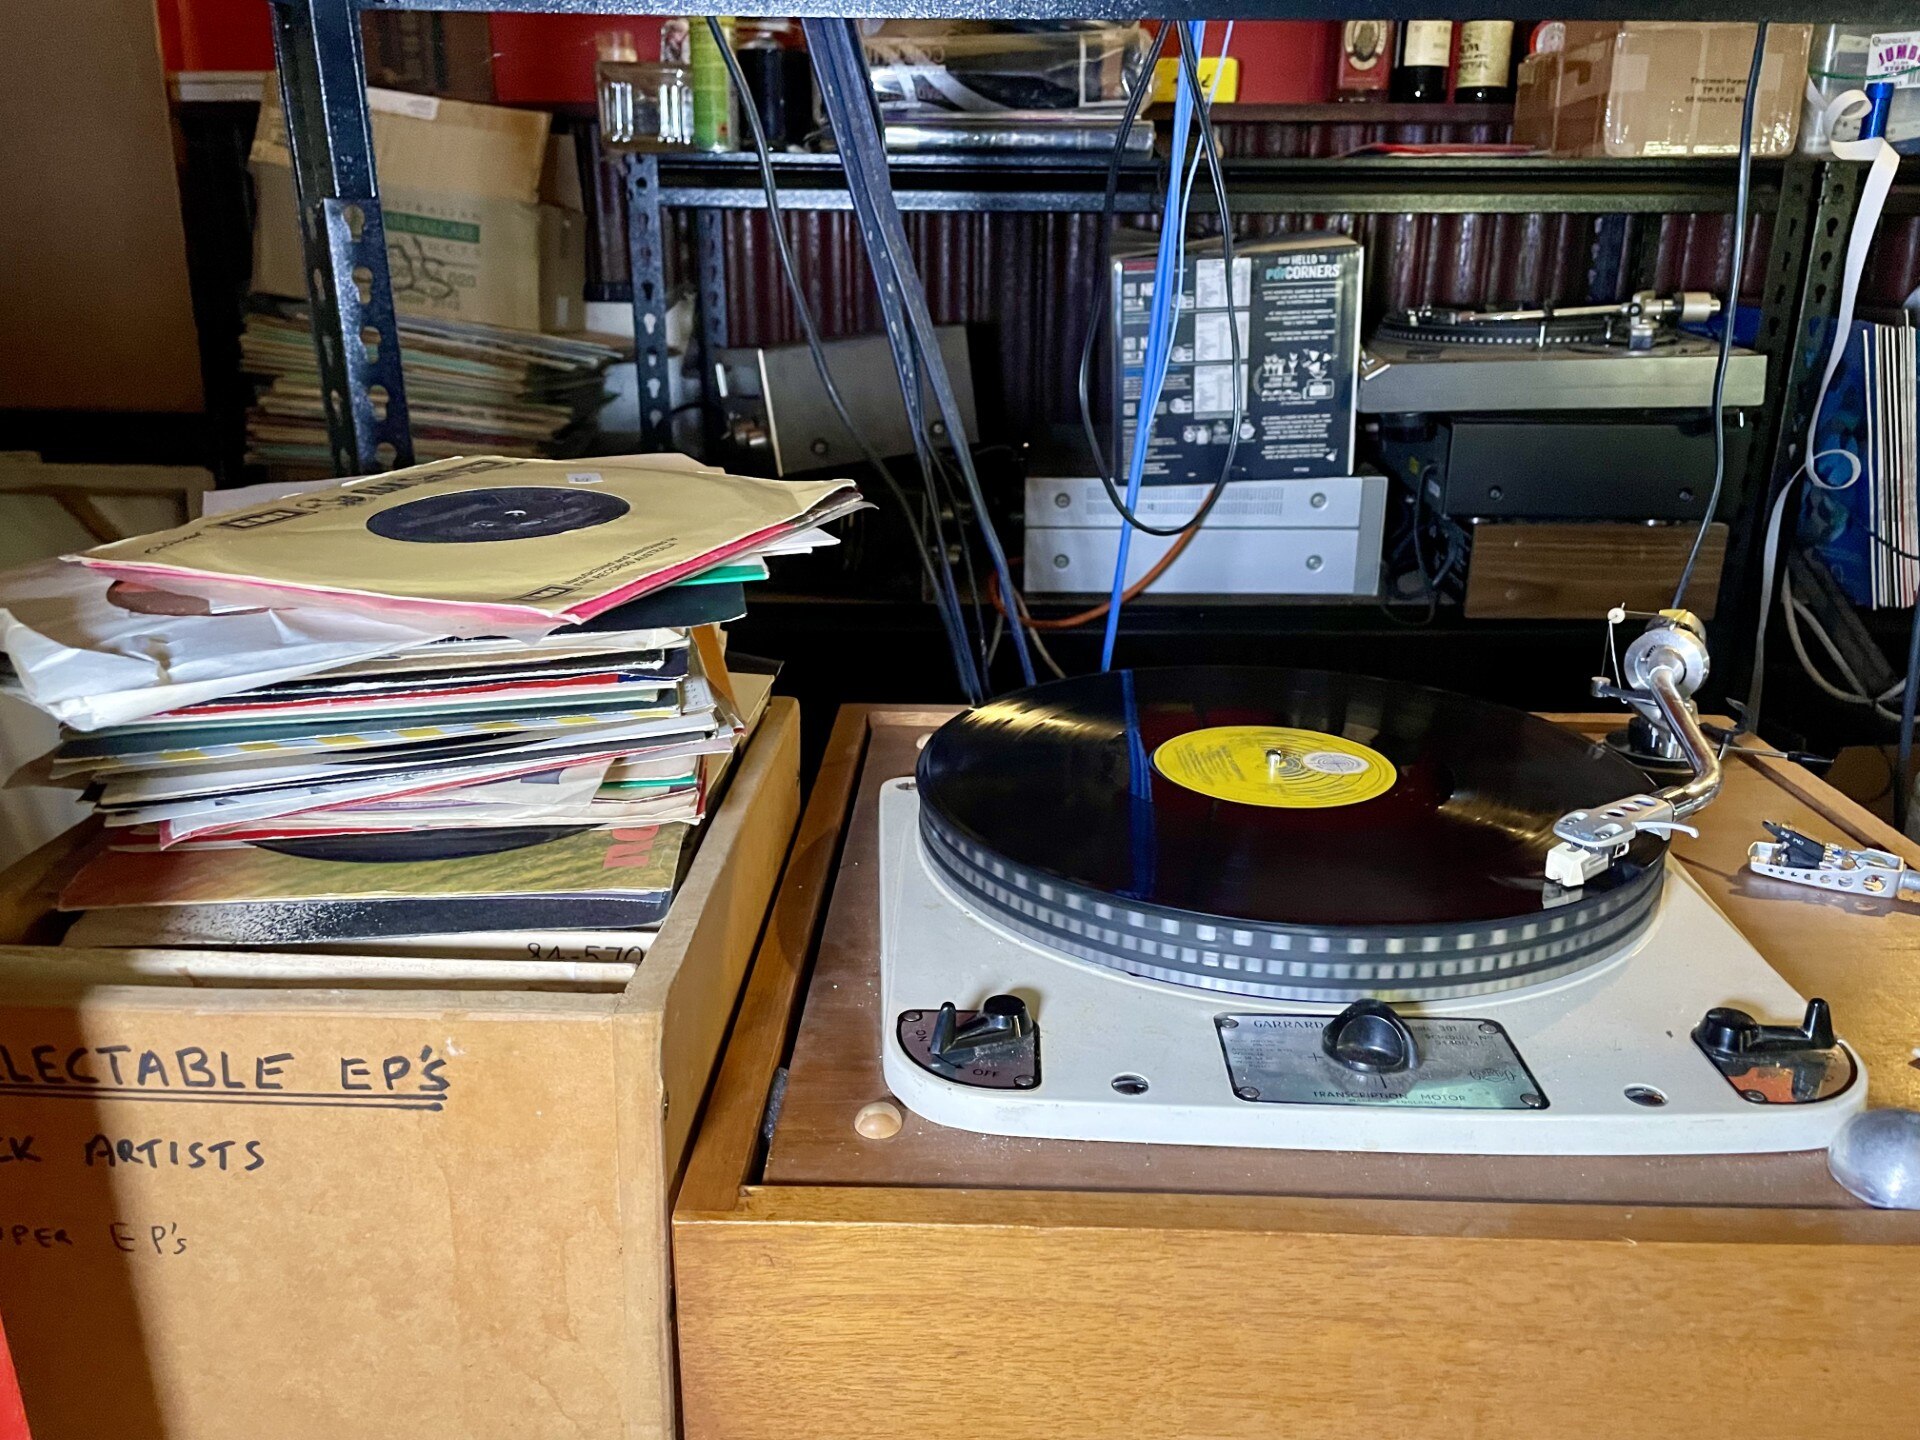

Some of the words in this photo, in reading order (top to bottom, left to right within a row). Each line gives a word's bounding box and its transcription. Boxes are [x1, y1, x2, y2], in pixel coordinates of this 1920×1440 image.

[1878, 44, 1920, 66] JUMB
[1291, 254, 1318, 265] HELLO
[1253, 1020, 1325, 1029] GARRARD
[0, 1045, 294, 1091] LECTABLE
[972, 1068, 1000, 1078] OFF
[1313, 1090, 1408, 1100] TRANSCRIPTION
[1421, 1093, 1467, 1102] MOTOR
[84, 1133, 266, 1171] ARTISTS
[0, 1223, 73, 1249] PER
